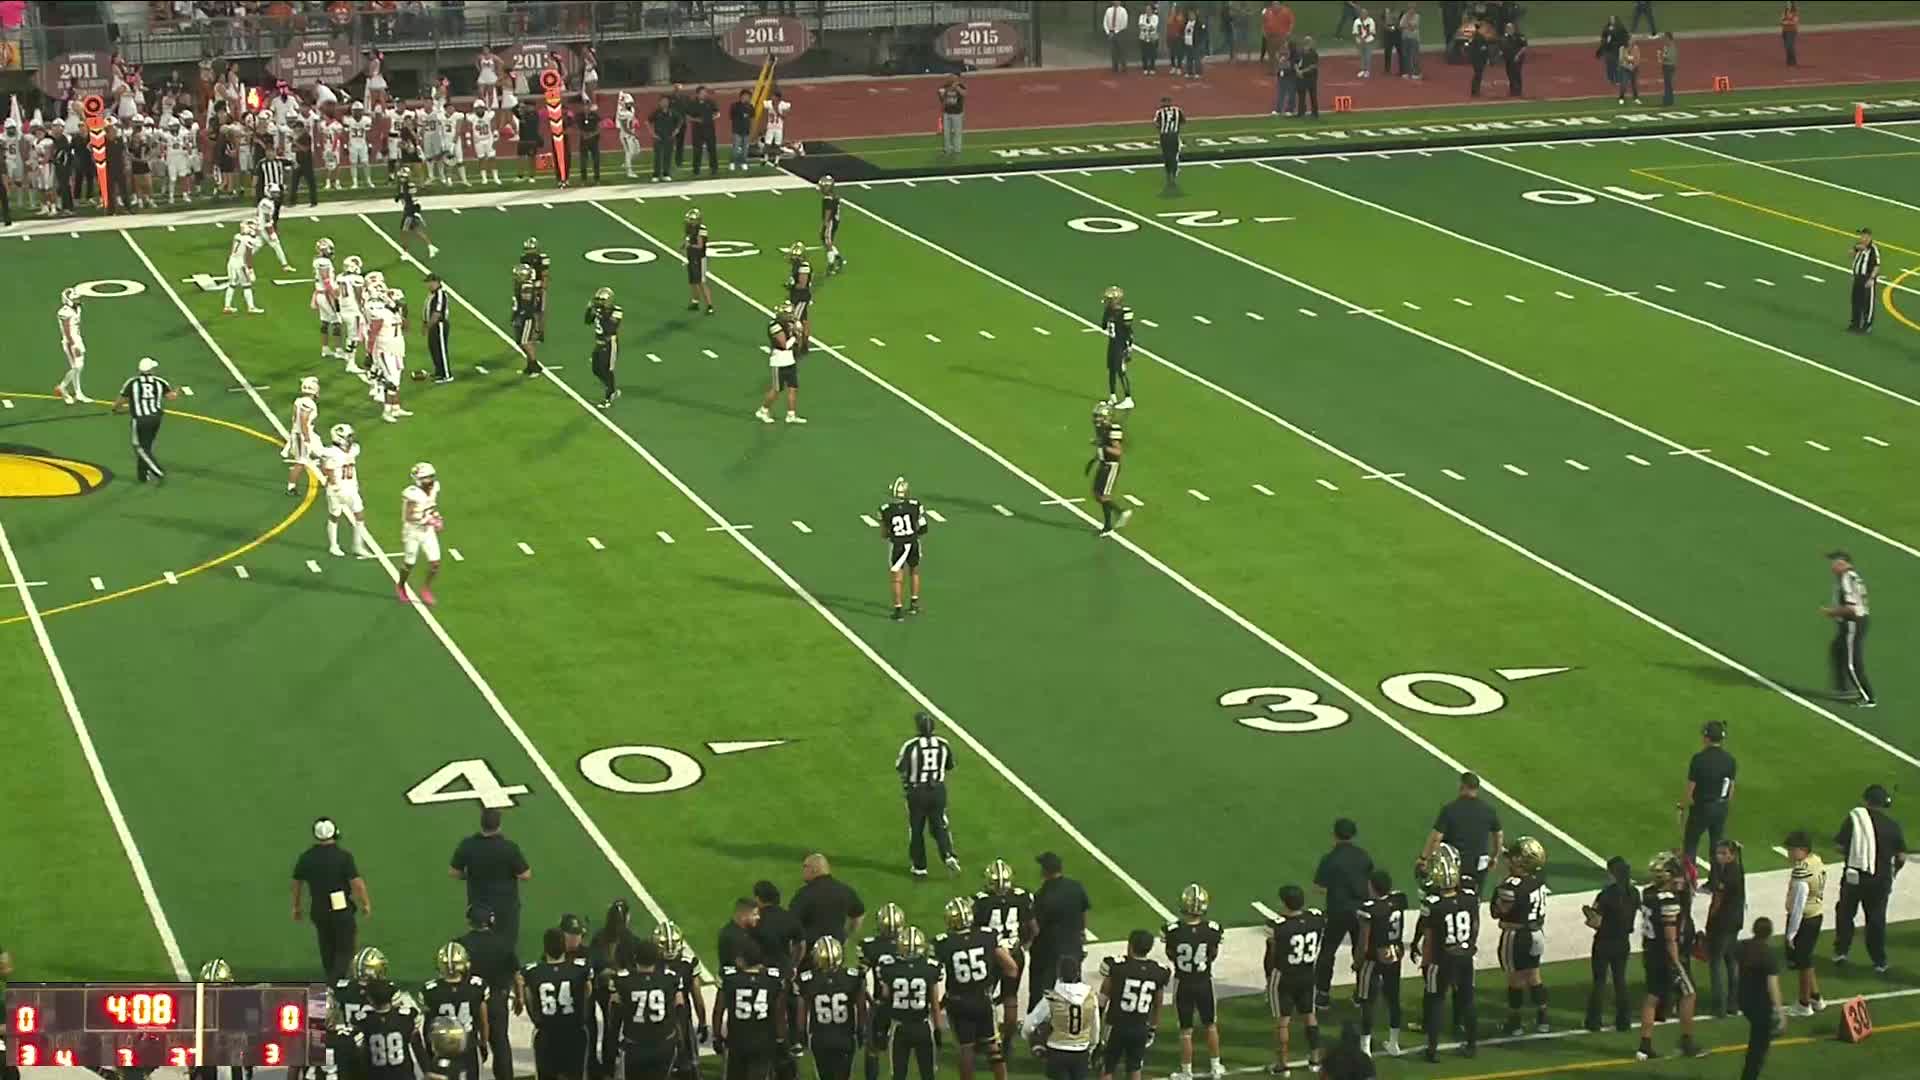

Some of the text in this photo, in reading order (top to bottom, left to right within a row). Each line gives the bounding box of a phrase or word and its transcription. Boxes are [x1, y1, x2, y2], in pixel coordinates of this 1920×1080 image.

[745, 27, 784, 43] 2014
[960, 30, 999, 45] 2015
[59, 63, 98, 79] 2011
[297, 50, 336, 65] 2012
[1279, 114, 1606, 139] MEMORIAL
[992, 134, 1270, 158] STDIUM
[141, 383, 153, 399] R
[892, 514, 914, 536] 21
[1218, 671, 1505, 733] 30
[921, 748, 940, 771] H
[404, 744, 704, 809] 40
[988, 906, 1020, 940] 44
[1444, 910, 1471, 944] 18
[1176, 943, 1208, 973] 24
[1287, 931, 1319, 965] 33
[952, 947, 988, 983] 65
[539, 981, 575, 1016] 64
[631, 989, 666, 1023] 79
[735, 988, 769, 1020] 54
[814, 993, 849, 1024] 66
[892, 978, 927, 1009] 23
[1120, 979, 1156, 1014] 56
[1068, 1005, 1082, 1035] 8
[1848, 1000, 1870, 1036] 30
[370, 1031, 405, 1066] 88
